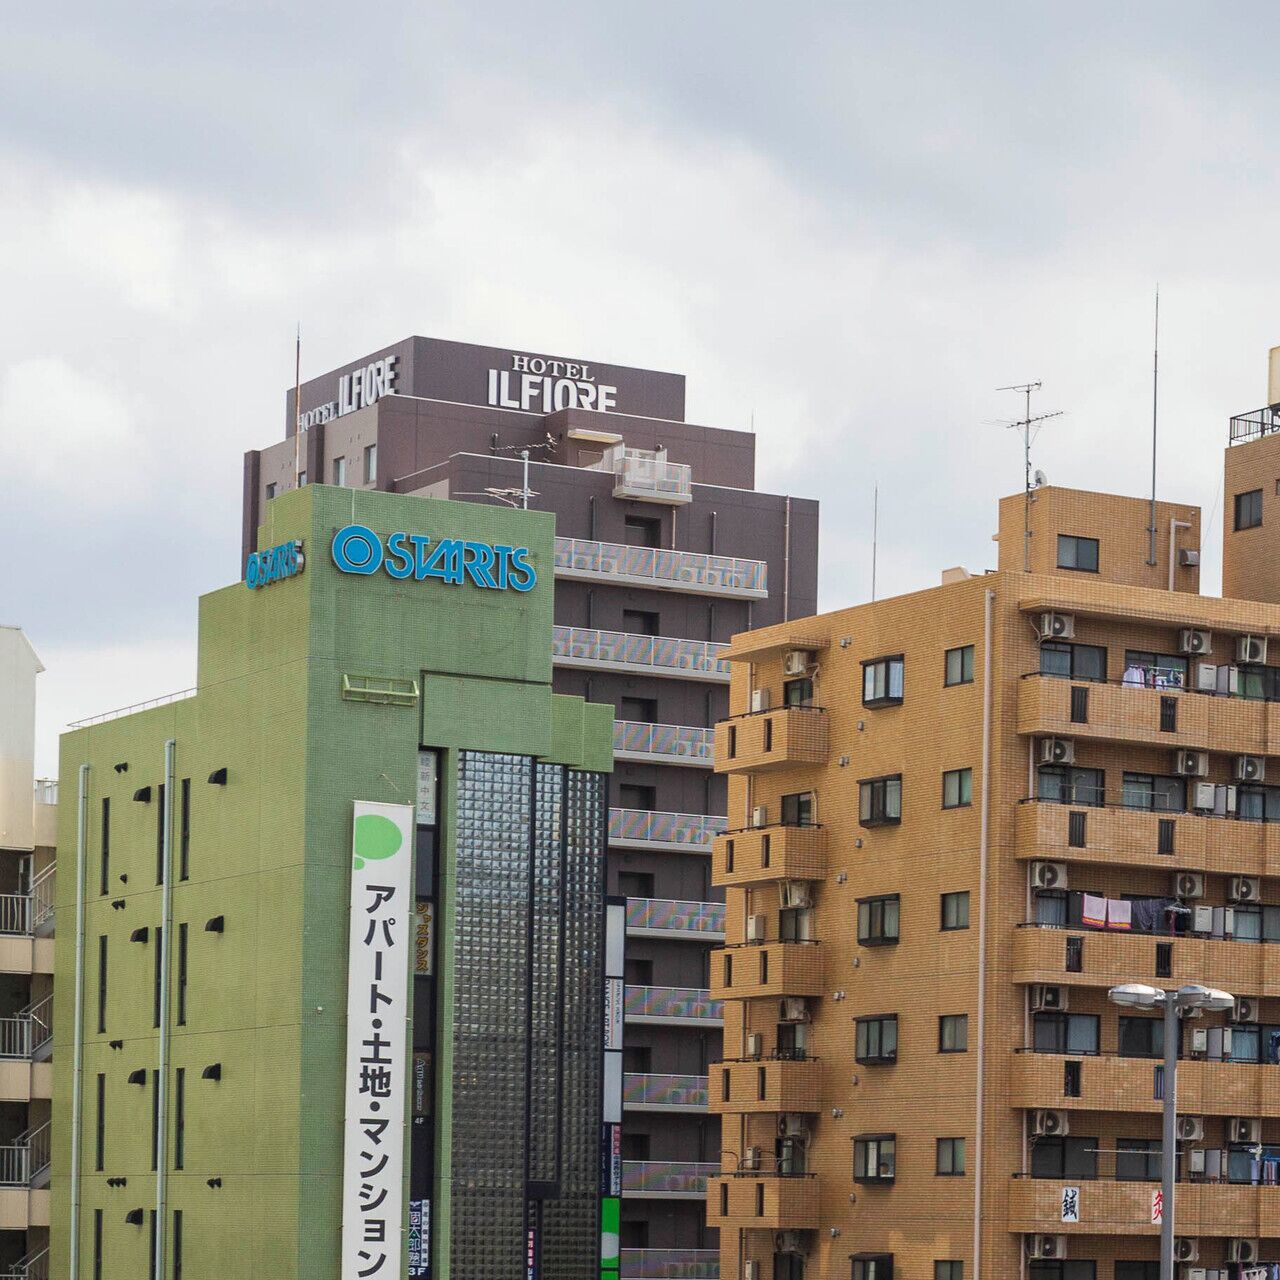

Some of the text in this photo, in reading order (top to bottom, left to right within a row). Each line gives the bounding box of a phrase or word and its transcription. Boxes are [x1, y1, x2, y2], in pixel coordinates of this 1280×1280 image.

[512, 355, 595, 382] HOTEL
[298, 355, 396, 433] HOTEL ILFIORE
[488, 369, 618, 412] ILFIORE
[385, 532, 537, 592] STARTS
[415, 1117, 425, 1125] 4F
